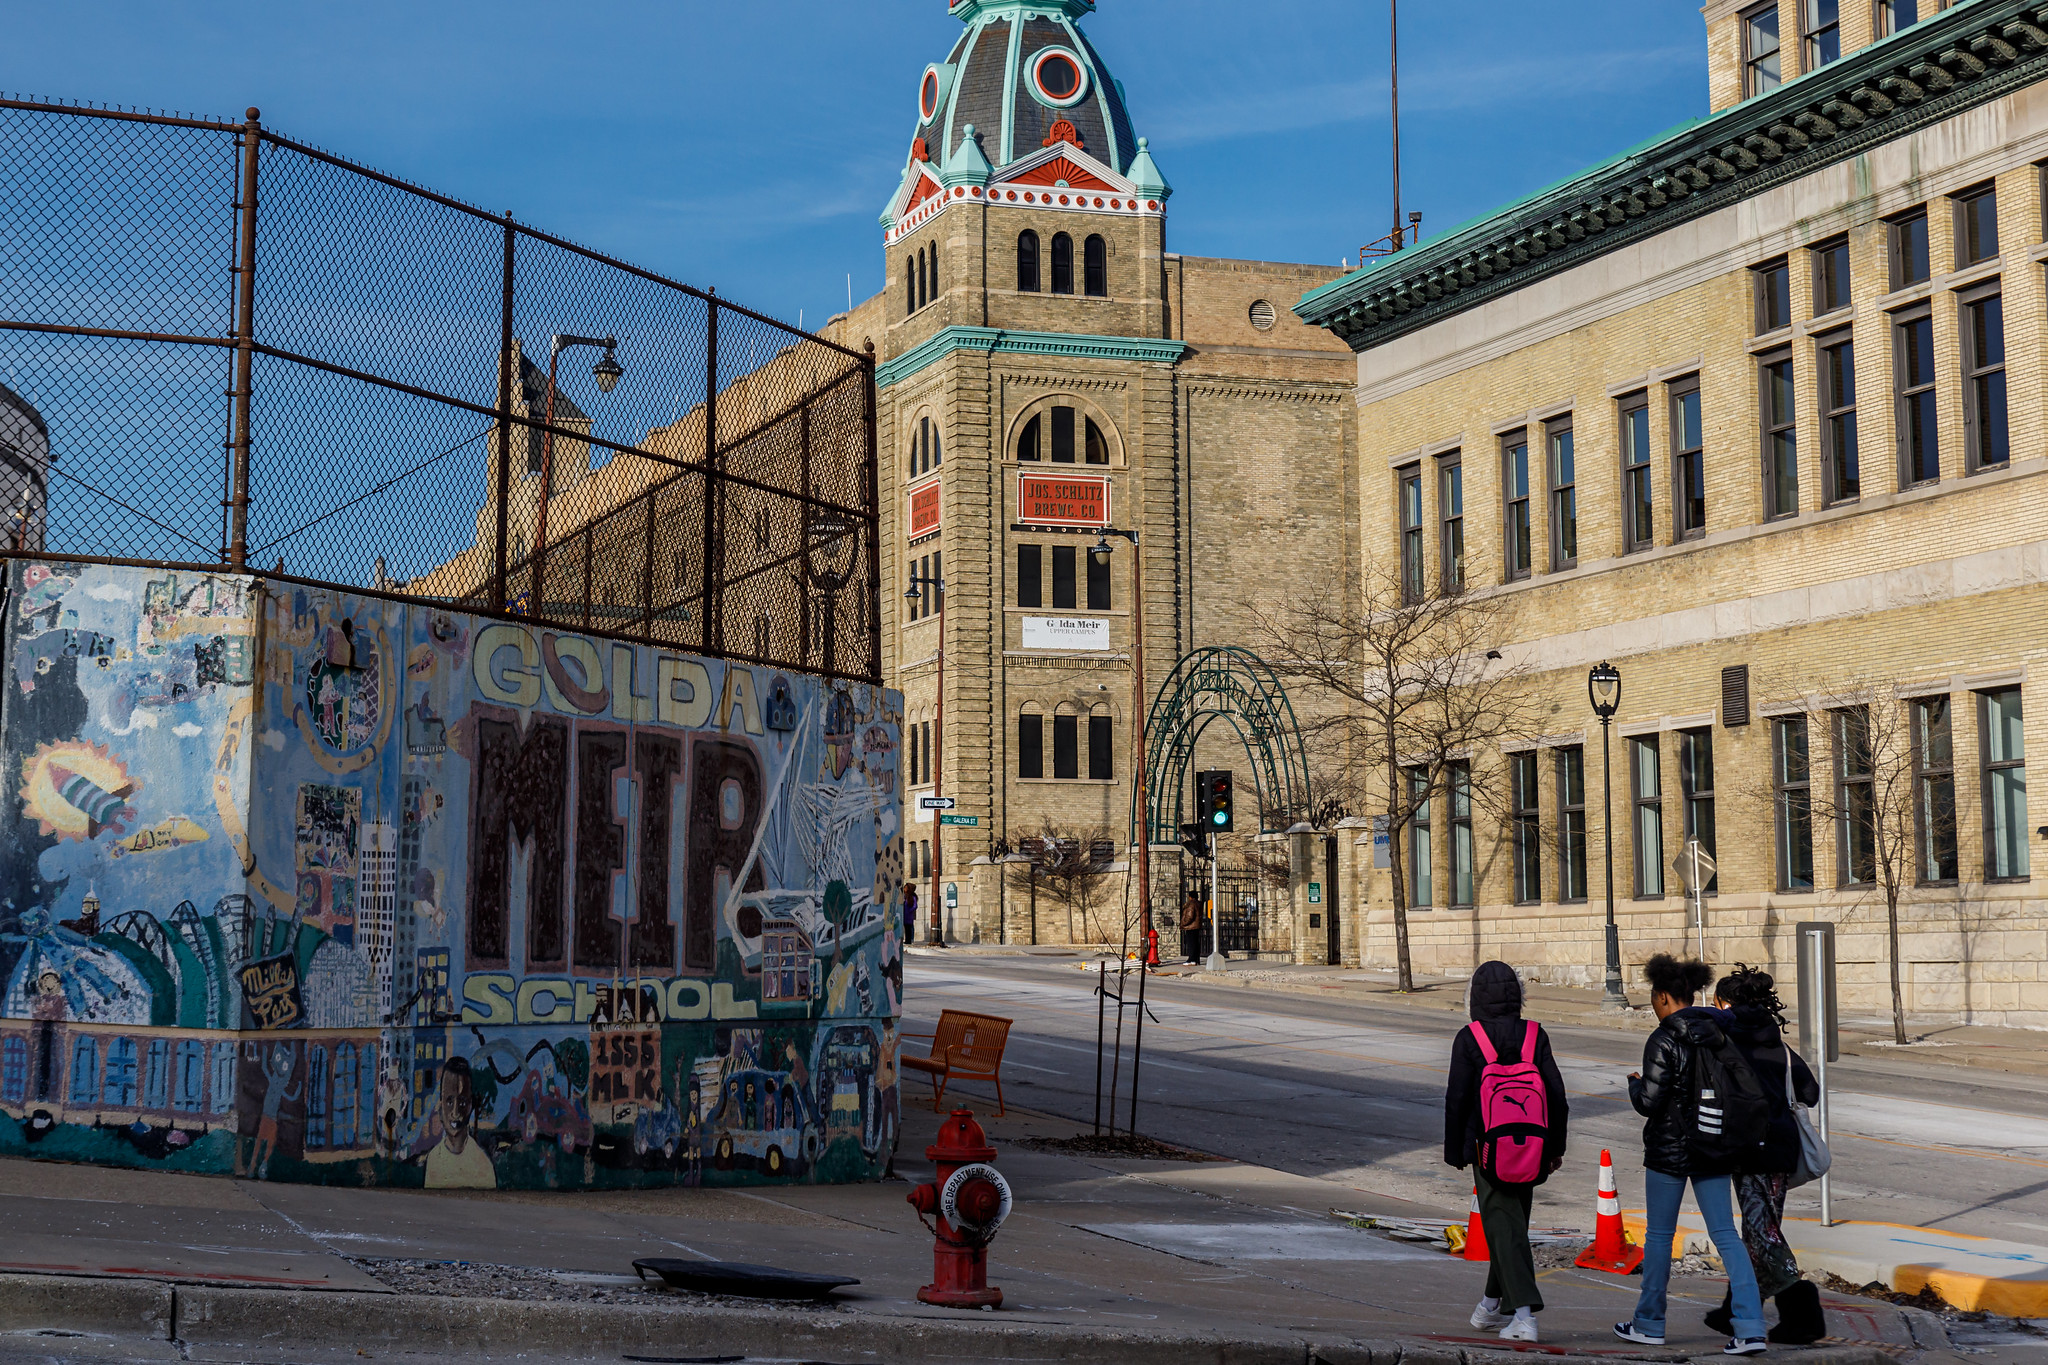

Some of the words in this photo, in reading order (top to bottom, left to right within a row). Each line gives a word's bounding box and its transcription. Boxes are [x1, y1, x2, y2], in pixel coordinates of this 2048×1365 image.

[1027, 483, 1052, 498] JOS.
[1055, 485, 1102, 500] SCHLITZ
[1081, 504, 1098, 518] CO.
[1077, 620, 1100, 629] Meir
[472, 623, 765, 737] GOLDA
[953, 816, 969, 824] GALENA
[466, 701, 768, 977] MEIR
[592, 1069, 656, 1103] MLK
[946, 1168, 985, 1198] DEPARTMENT
[985, 1170, 999, 1184] USE
[996, 1183, 1008, 1202] ONLY
